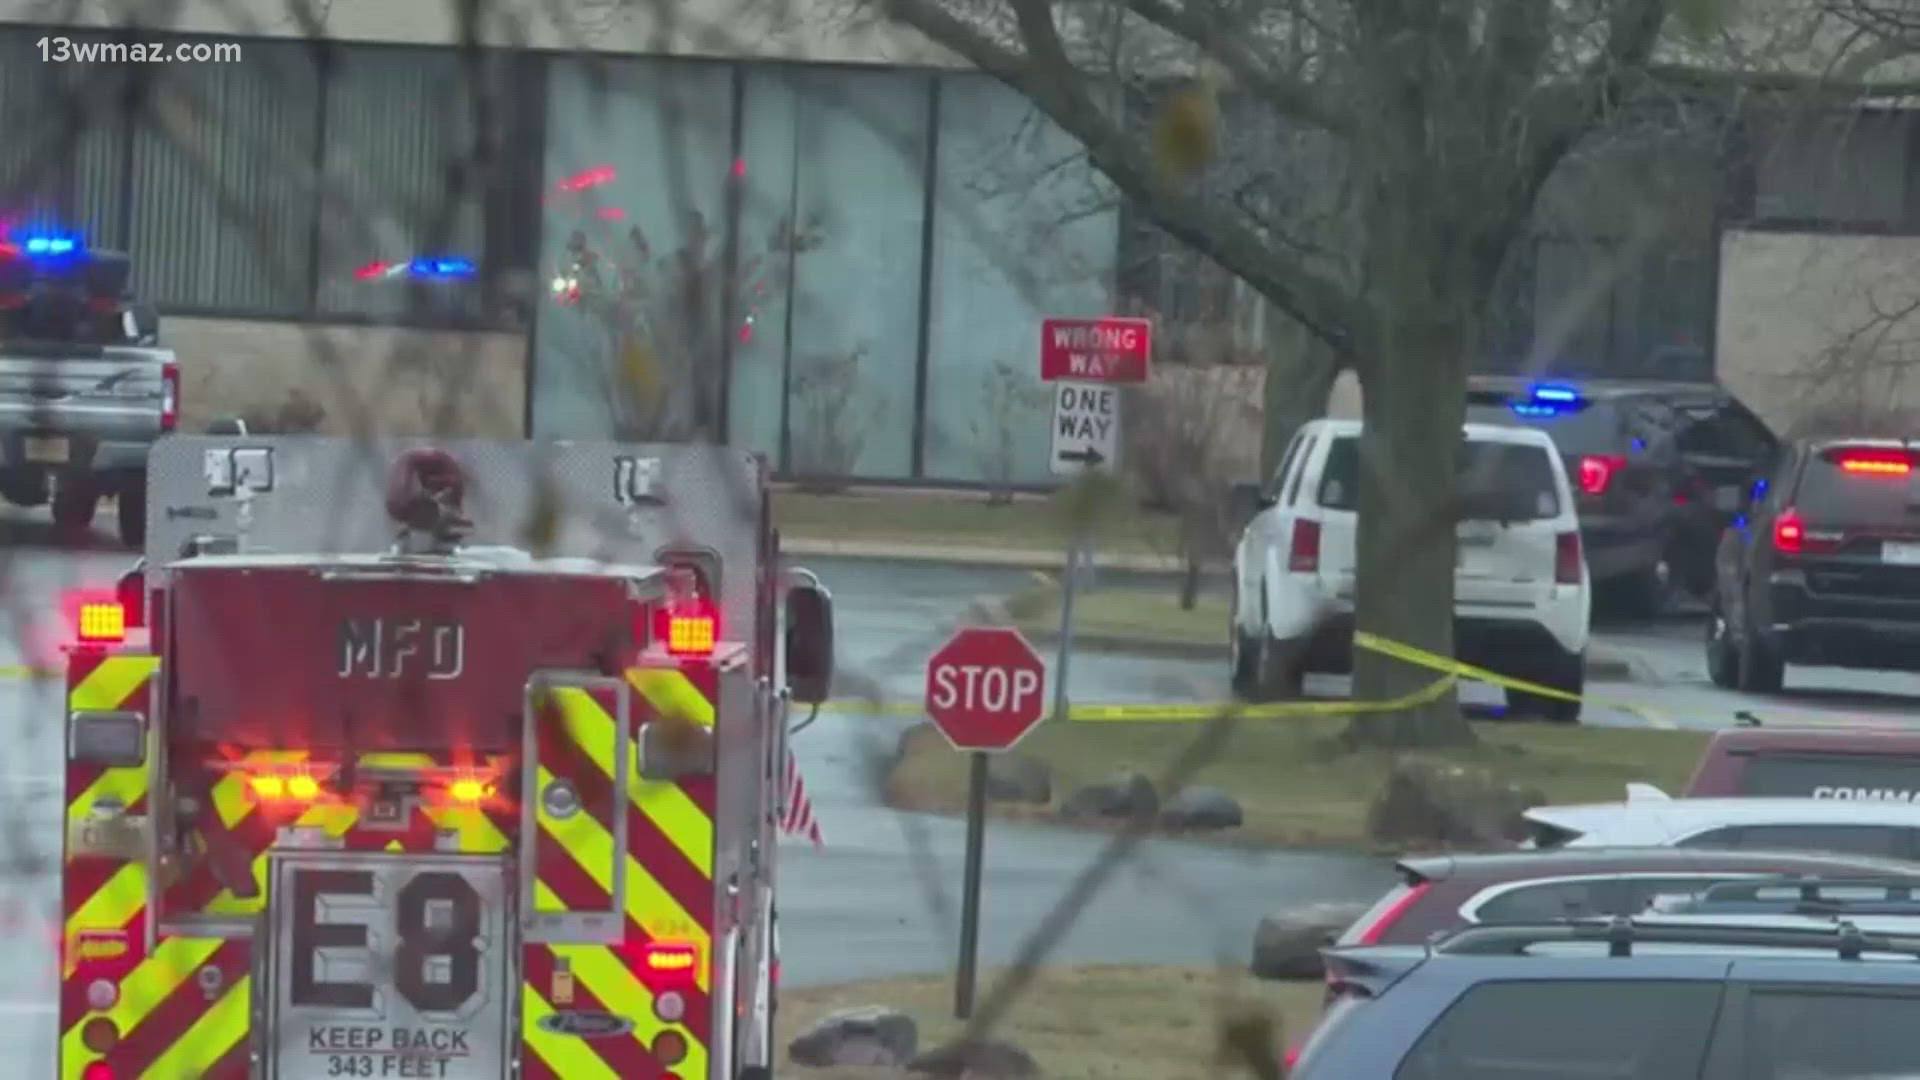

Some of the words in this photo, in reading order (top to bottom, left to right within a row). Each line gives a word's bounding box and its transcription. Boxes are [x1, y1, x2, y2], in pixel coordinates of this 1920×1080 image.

[1054, 327, 1137, 350] WRONG
[1069, 353, 1121, 376] WAY
[1061, 387, 1113, 414] ONE
[1059, 416, 1112, 440] WAY
[336, 617, 464, 679] MFD
[933, 663, 1038, 713] STOP
[292, 869, 486, 1015] E8
[309, 1027, 384, 1049] KEEP
[392, 1028, 470, 1051] BACK
[328, 1056, 373, 1077] 343
[382, 1056, 451, 1078] FEET
